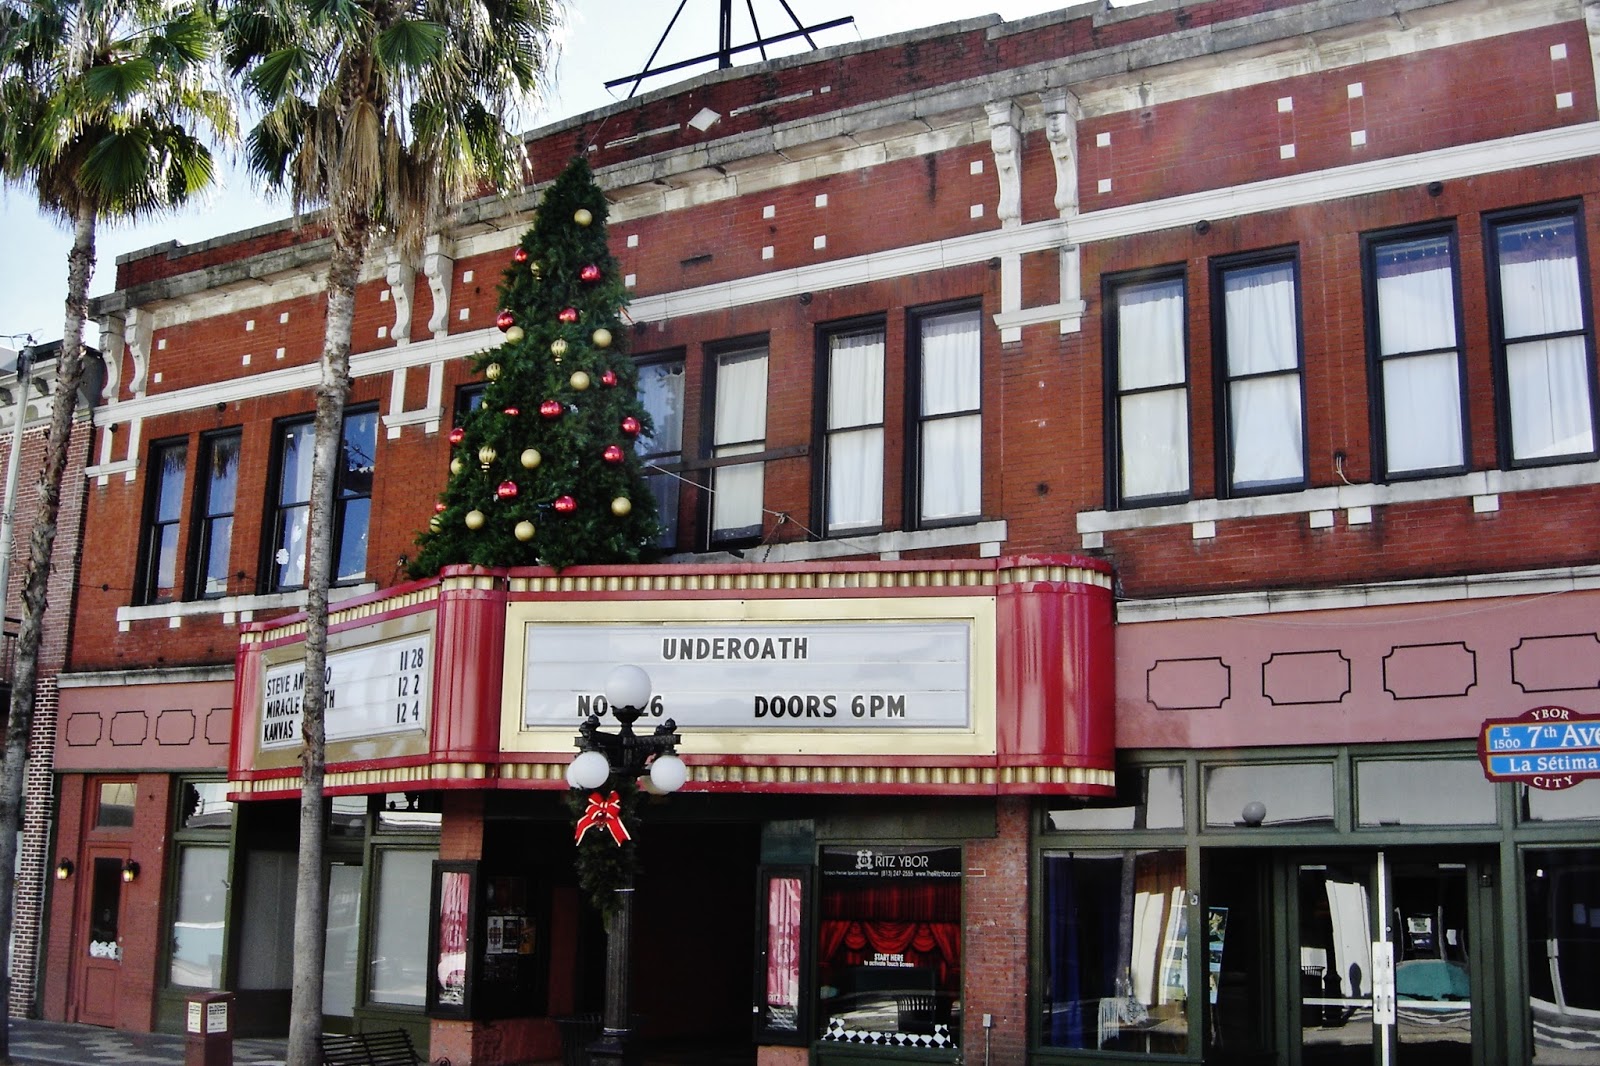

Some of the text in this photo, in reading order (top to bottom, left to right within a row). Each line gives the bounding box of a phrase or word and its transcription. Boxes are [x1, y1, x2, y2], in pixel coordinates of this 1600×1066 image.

[411, 647, 424, 669] 28
[662, 637, 808, 660] UNDEROATH
[266, 675, 290, 697] STEVE
[398, 674, 420, 697] 12 2
[266, 697, 300, 719] MIRACLE
[396, 700, 419, 724] 12 4
[577, 695, 609, 717] NO
[754, 695, 906, 718] DOORS 6PM
[1531, 708, 1569, 721] YBOR
[264, 720, 293, 741] KANVAS
[1502, 727, 1511, 737] E
[1527, 726, 1557, 748] 7th
[1494, 739, 1521, 749] 1500
[1509, 755, 1598, 772] La Sétima
[1533, 775, 1573, 788] CITY
[875, 855, 896, 867] RITZ
[898, 855, 929, 868] YBOR
[874, 953, 890, 961] START
